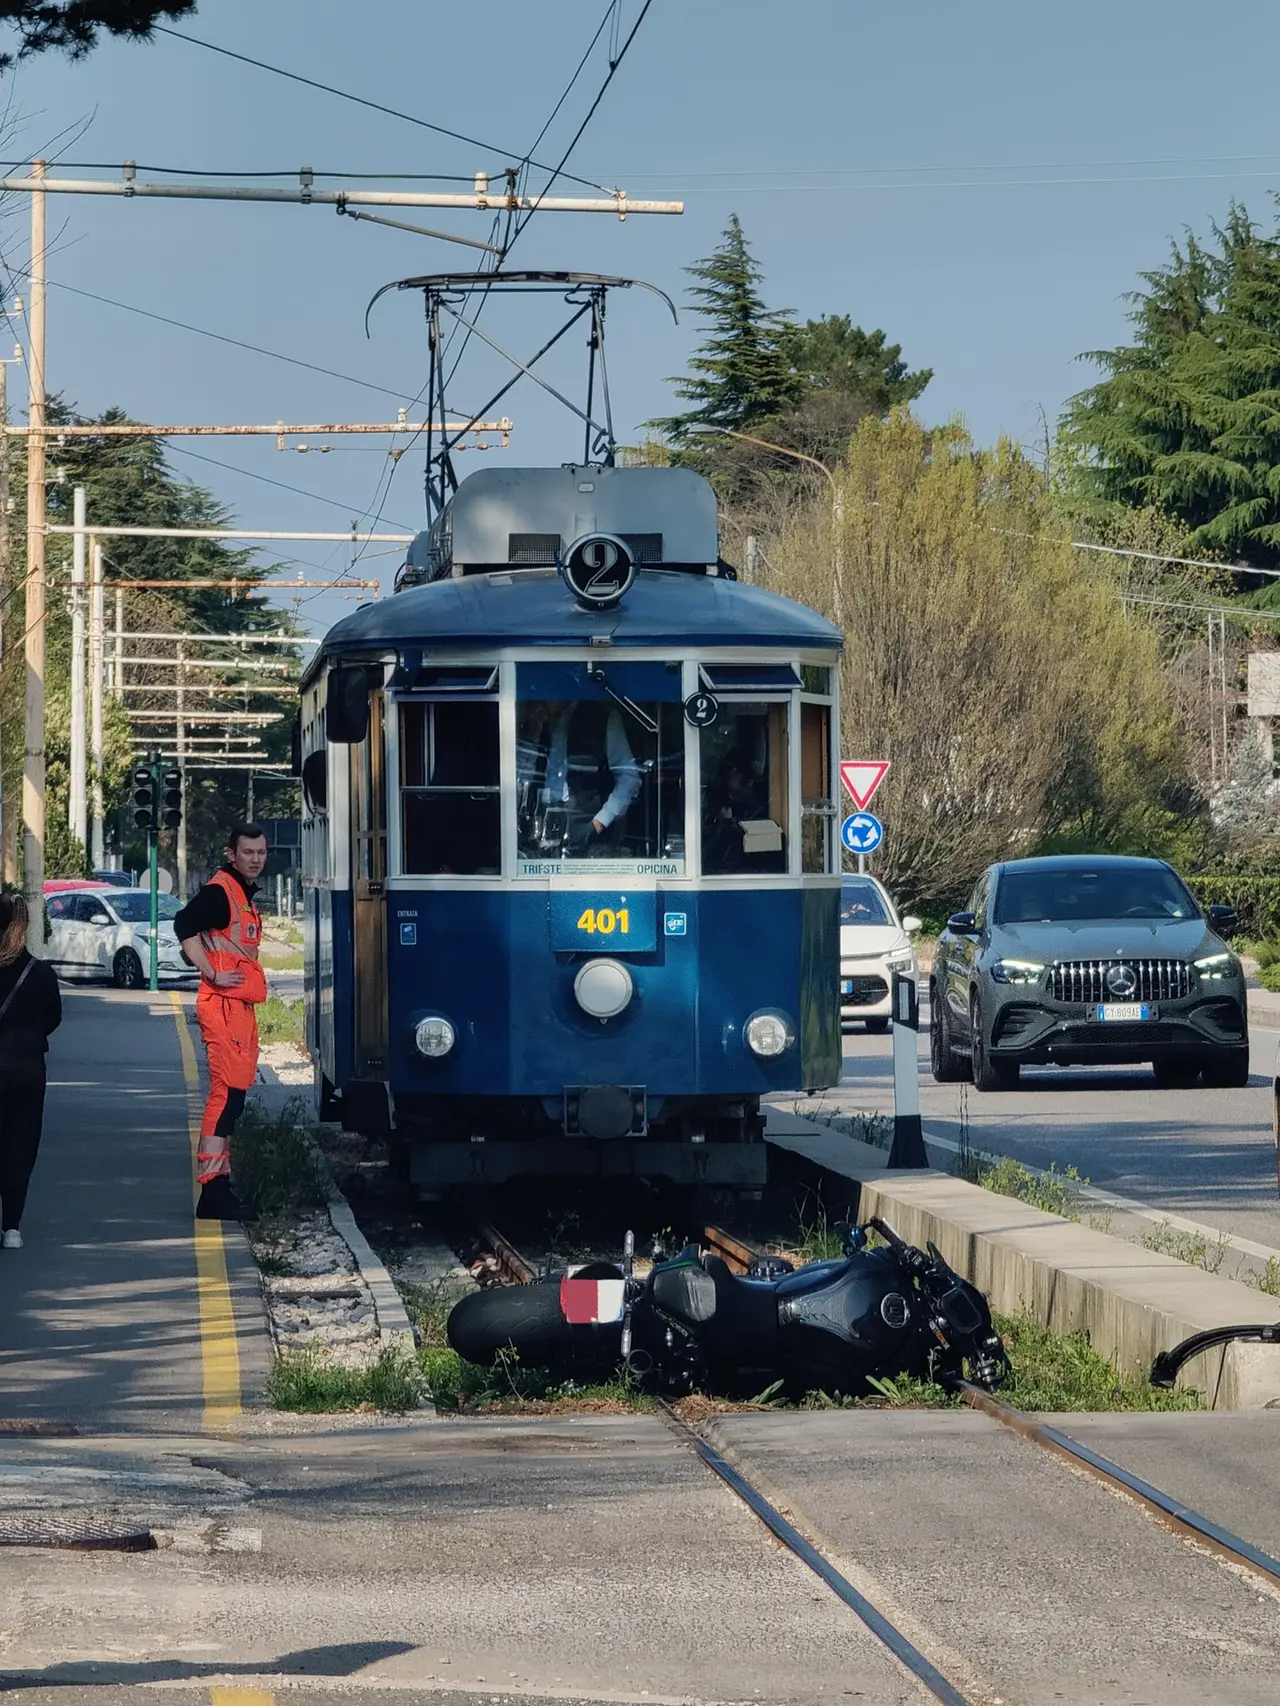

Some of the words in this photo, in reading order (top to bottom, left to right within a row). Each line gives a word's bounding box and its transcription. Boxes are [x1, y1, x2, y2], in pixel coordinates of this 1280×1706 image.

[581, 539, 620, 595] 2
[696, 698, 708, 718] 2
[522, 864, 562, 874] TRIESTE
[637, 864, 678, 874] OPICINA
[577, 909, 629, 934] 401
